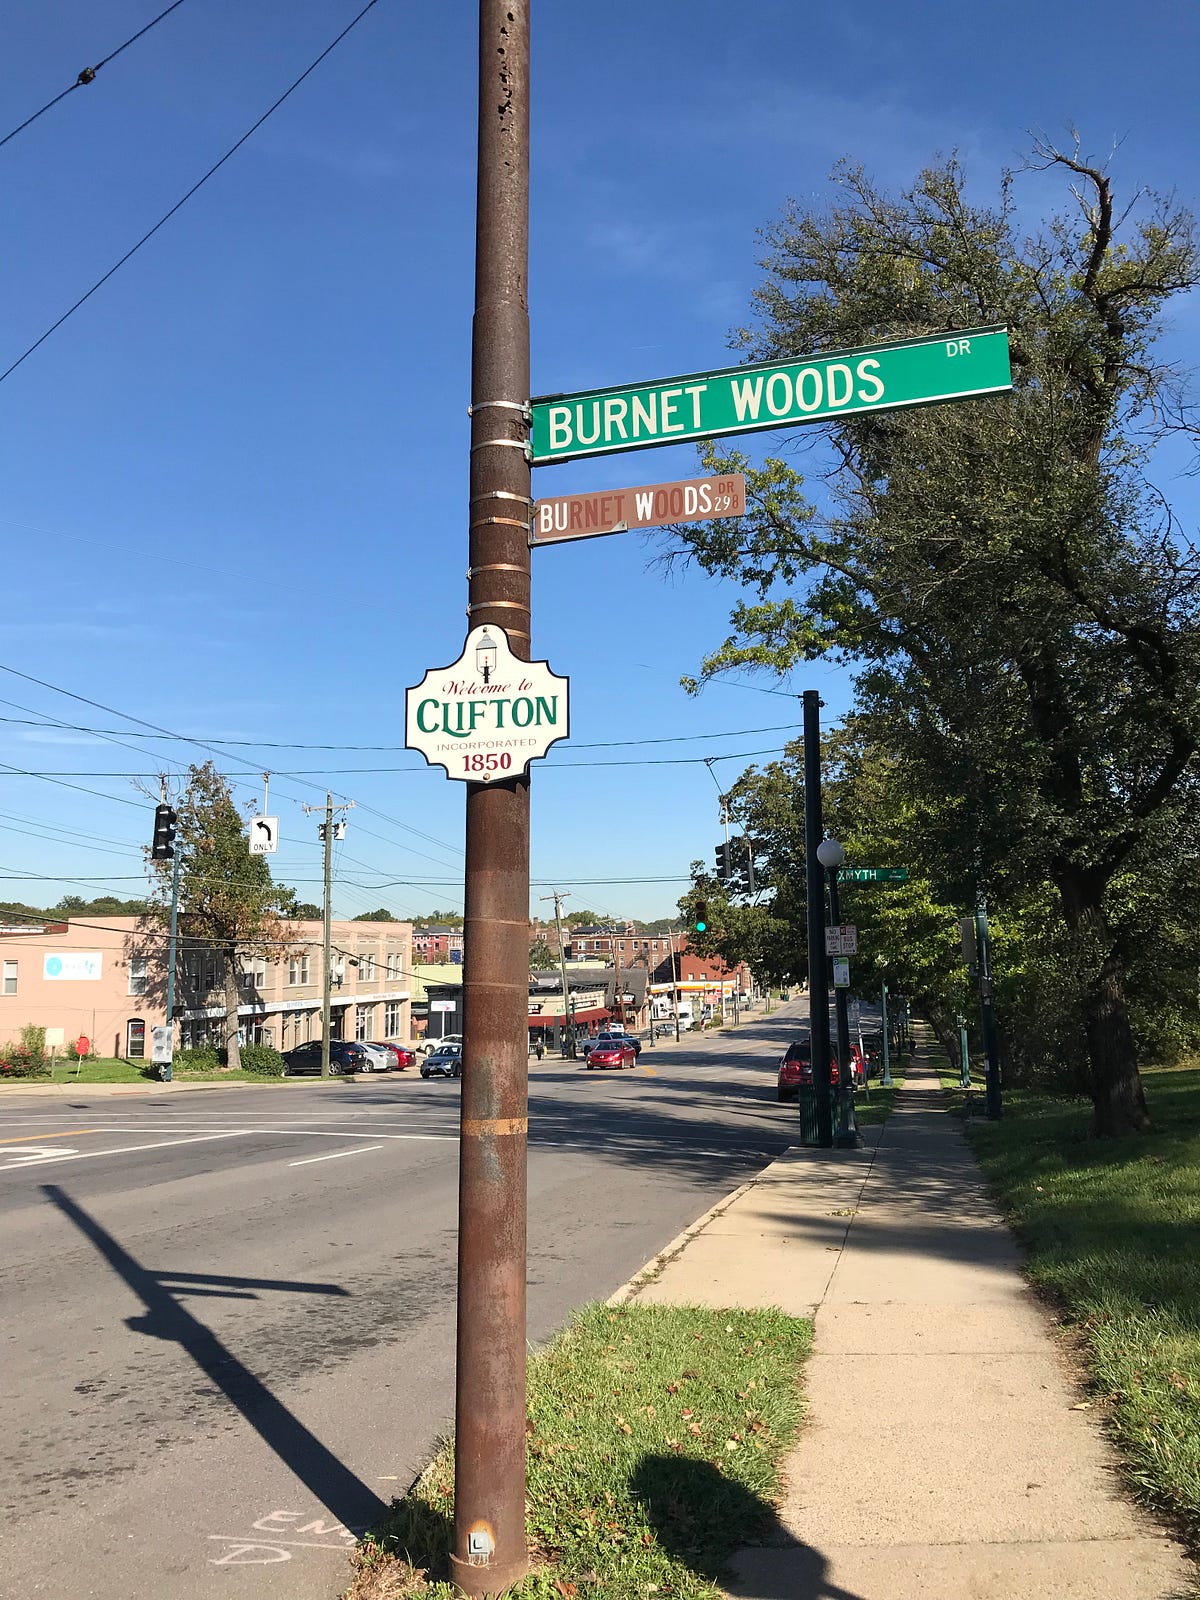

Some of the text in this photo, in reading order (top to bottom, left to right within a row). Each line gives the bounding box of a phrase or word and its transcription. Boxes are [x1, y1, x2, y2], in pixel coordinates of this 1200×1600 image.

[549, 339, 972, 450] BURNET WOODS DR
[718, 481, 734, 494] DR
[540, 483, 713, 534] BURNET WOODS
[714, 494, 739, 512] 298
[442, 678, 533, 696] Welcome to
[416, 695, 559, 738] CLIFTON
[437, 738, 537, 752] INCORPORATED
[462, 752, 512, 772] 1850
[253, 842, 274, 852] ONLY
[838, 869, 877, 881] XMYTH
